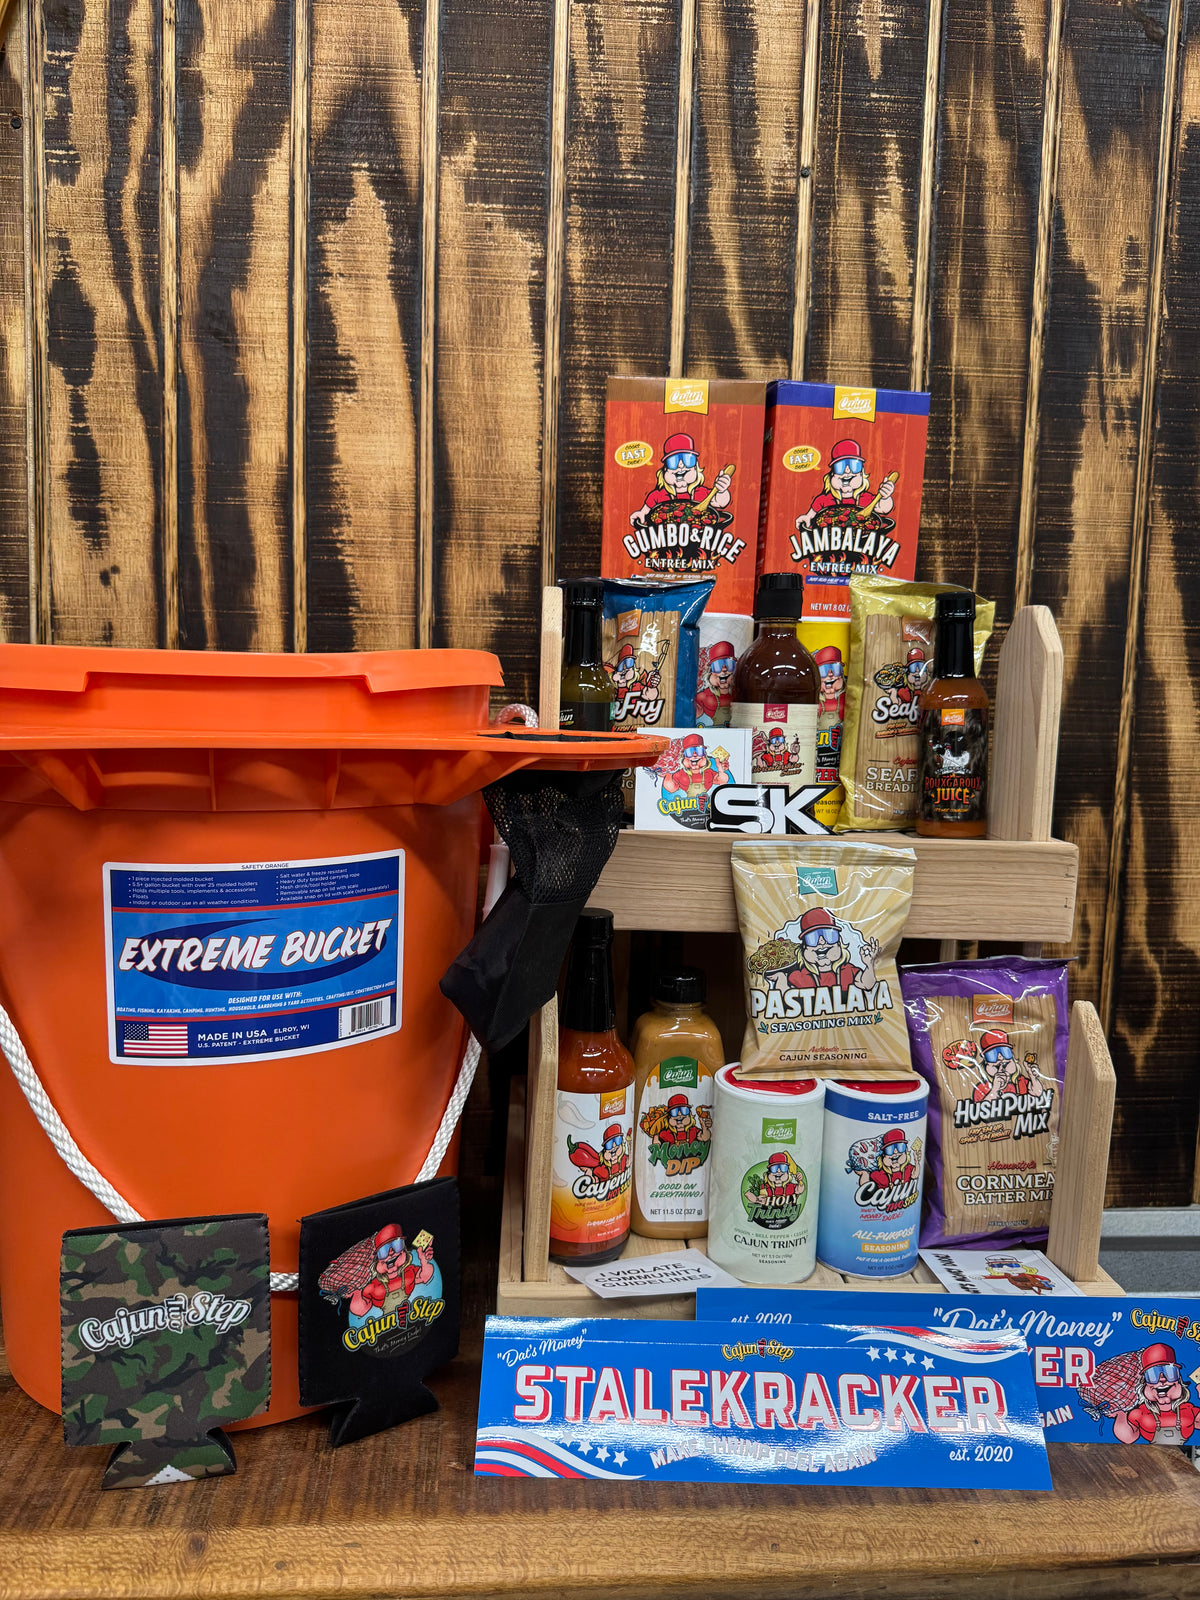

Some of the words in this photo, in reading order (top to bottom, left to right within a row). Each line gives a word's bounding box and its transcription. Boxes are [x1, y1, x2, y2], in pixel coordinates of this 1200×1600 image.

[621, 448, 646, 461] FAST
[789, 453, 813, 465] FAST
[789, 526, 900, 567] JAMBALAYA
[691, 559, 714, 569] MIX
[855, 564, 878, 575] MIX
[810, 603, 821, 611] NET
[822, 603, 832, 611] WT
[838, 604, 846, 612] OZ
[872, 695, 919, 723] Seaf
[866, 767, 918, 782] SEAF
[866, 782, 915, 792] BREADI
[925, 776, 981, 791] ROUXGAROUX
[657, 797, 697, 816] Cajun
[697, 793, 708, 813] Two
[934, 787, 970, 805] JUICE
[118, 935, 278, 973] EXTREME
[279, 918, 393, 967] BUCKET
[228, 996, 257, 1004] DESIGNED
[258, 994, 271, 1002] FOR
[271, 993, 283, 1001] USE
[284, 991, 302, 999] WITH:
[750, 980, 893, 1019] PASTALAYA
[770, 1018, 845, 1033] SEASONING
[846, 1015, 873, 1027] MIX
[197, 1032, 229, 1041] MADE
[232, 1031, 242, 1039] IN
[246, 1029, 267, 1038] USA
[273, 1026, 299, 1034] ELROY,
[243, 1037, 274, 1046] EXTREME
[274, 1034, 300, 1043] BUCKET
[813, 1052, 867, 1061] SEASONING
[868, 1110, 919, 1121] SALT-FREE
[665, 1156, 701, 1176] DIP
[573, 1167, 632, 1200] Cayenn
[956, 1172, 1056, 1191] CORNMEA
[607, 1188, 620, 1200] HOT
[650, 1190, 704, 1199] EVERYTHING!
[765, 1194, 798, 1206] HOLY
[855, 1179, 918, 1209] Cajun
[886, 1200, 904, 1212] TWO
[903, 1190, 919, 1207] STEP
[964, 1190, 1025, 1206] BATTER
[747, 1202, 801, 1222] Trinity
[733, 1234, 769, 1248] CAJUN
[770, 1235, 809, 1248] TRINITY
[852, 1224, 916, 1241] ALL-PURPOSE
[864, 1241, 909, 1252] SEASONING
[595, 1267, 701, 1283] COMMUNITY
[608, 1262, 686, 1276] VIOLATE
[602, 1273, 712, 1288] GUIDELINES
[80, 1304, 166, 1351] Cajun
[165, 1292, 188, 1334] Two
[186, 1290, 252, 1334] Step
[343, 1311, 397, 1351] Cajun
[397, 1301, 408, 1327] Two
[409, 1297, 445, 1325] Step
[1018, 1309, 1122, 1347] Money"
[1130, 1308, 1175, 1334] Cajun
[1175, 1316, 1190, 1338] Two
[497, 1344, 537, 1367] "Dat's
[539, 1328, 587, 1355] Money"
[722, 1341, 757, 1361] Cajun
[766, 1339, 795, 1362] Step
[513, 1364, 1009, 1434] STALEKRACKER
[649, 1438, 700, 1469] MAKE
[704, 1436, 770, 1460] SHRIMP
[774, 1448, 819, 1473] PEEL
[824, 1443, 877, 1473] AGAIN
[949, 1446, 971, 1462] est.
[974, 1445, 1013, 1463] 2020
